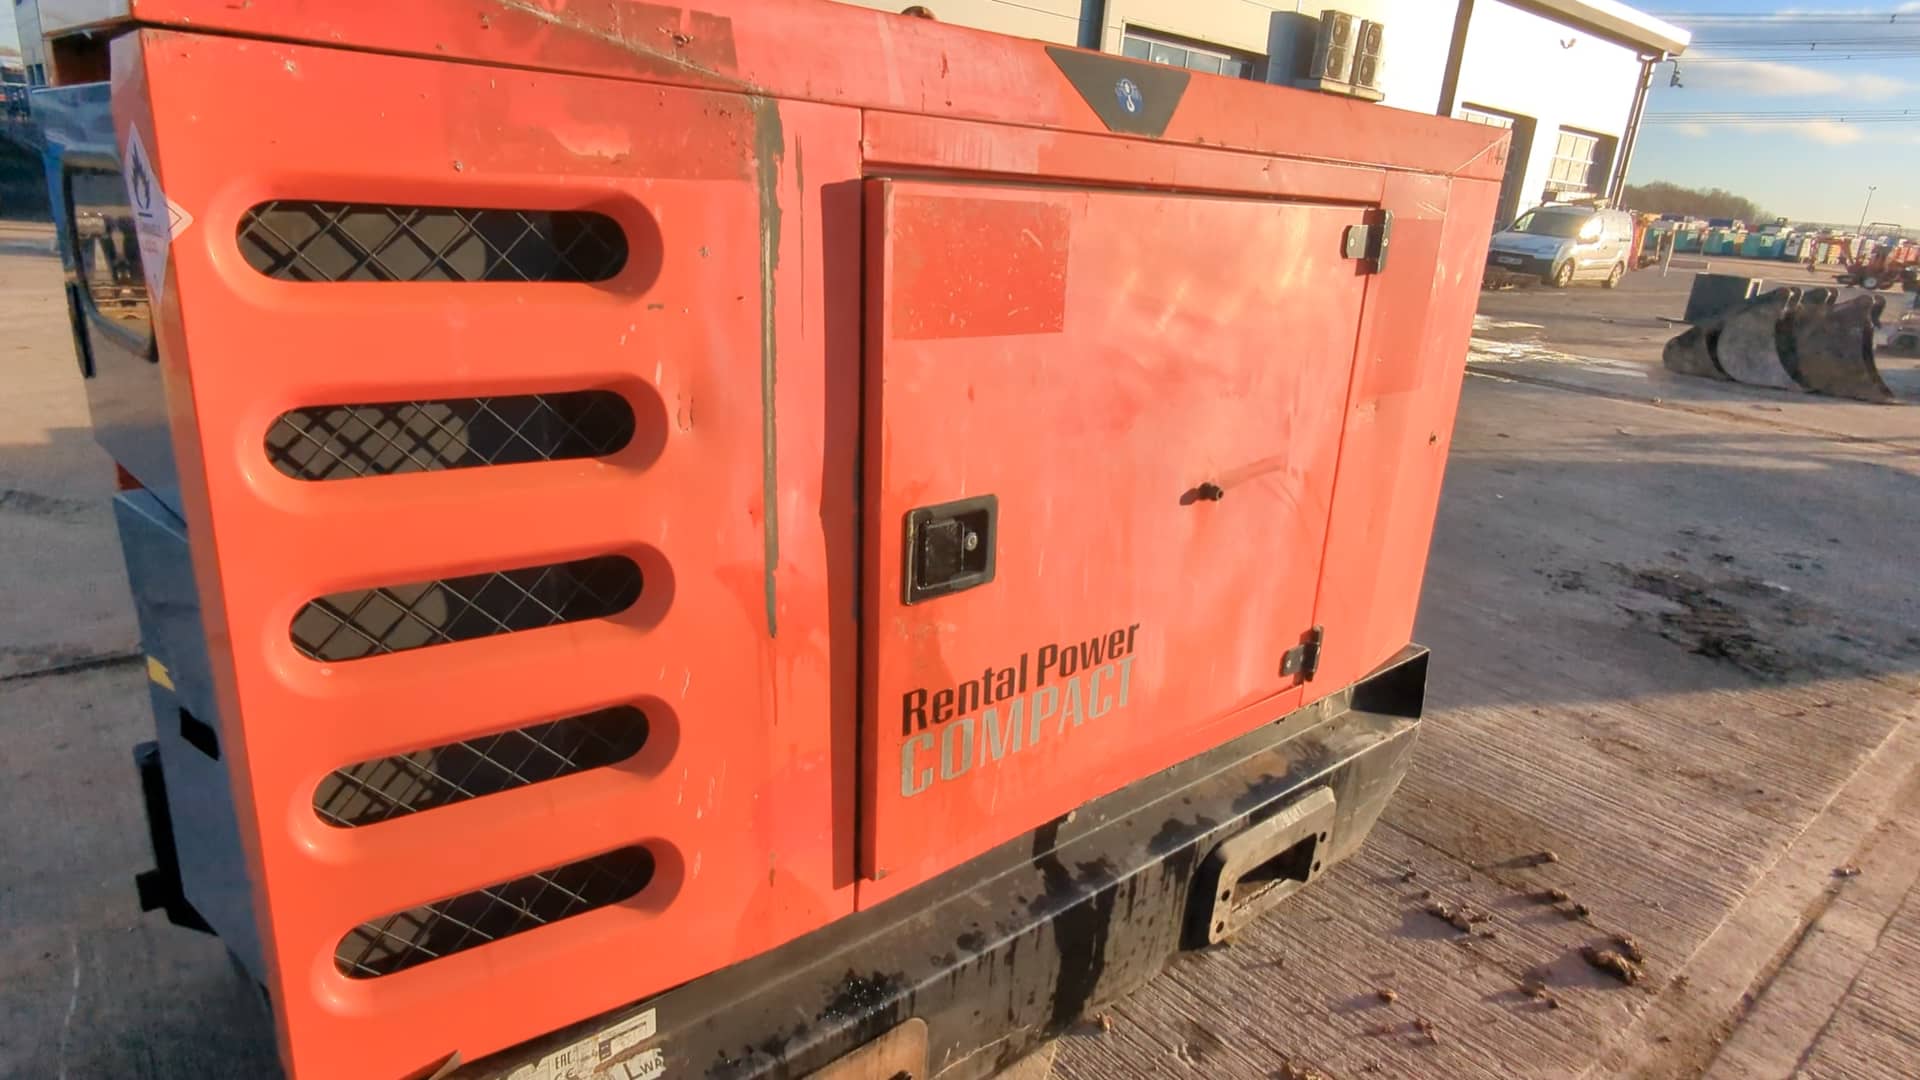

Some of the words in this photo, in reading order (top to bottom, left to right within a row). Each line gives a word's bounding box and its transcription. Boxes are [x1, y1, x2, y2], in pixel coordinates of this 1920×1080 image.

[901, 655, 1136, 798] COMPACT
[902, 652, 1028, 737] Rental
[1037, 623, 1140, 687] Power
